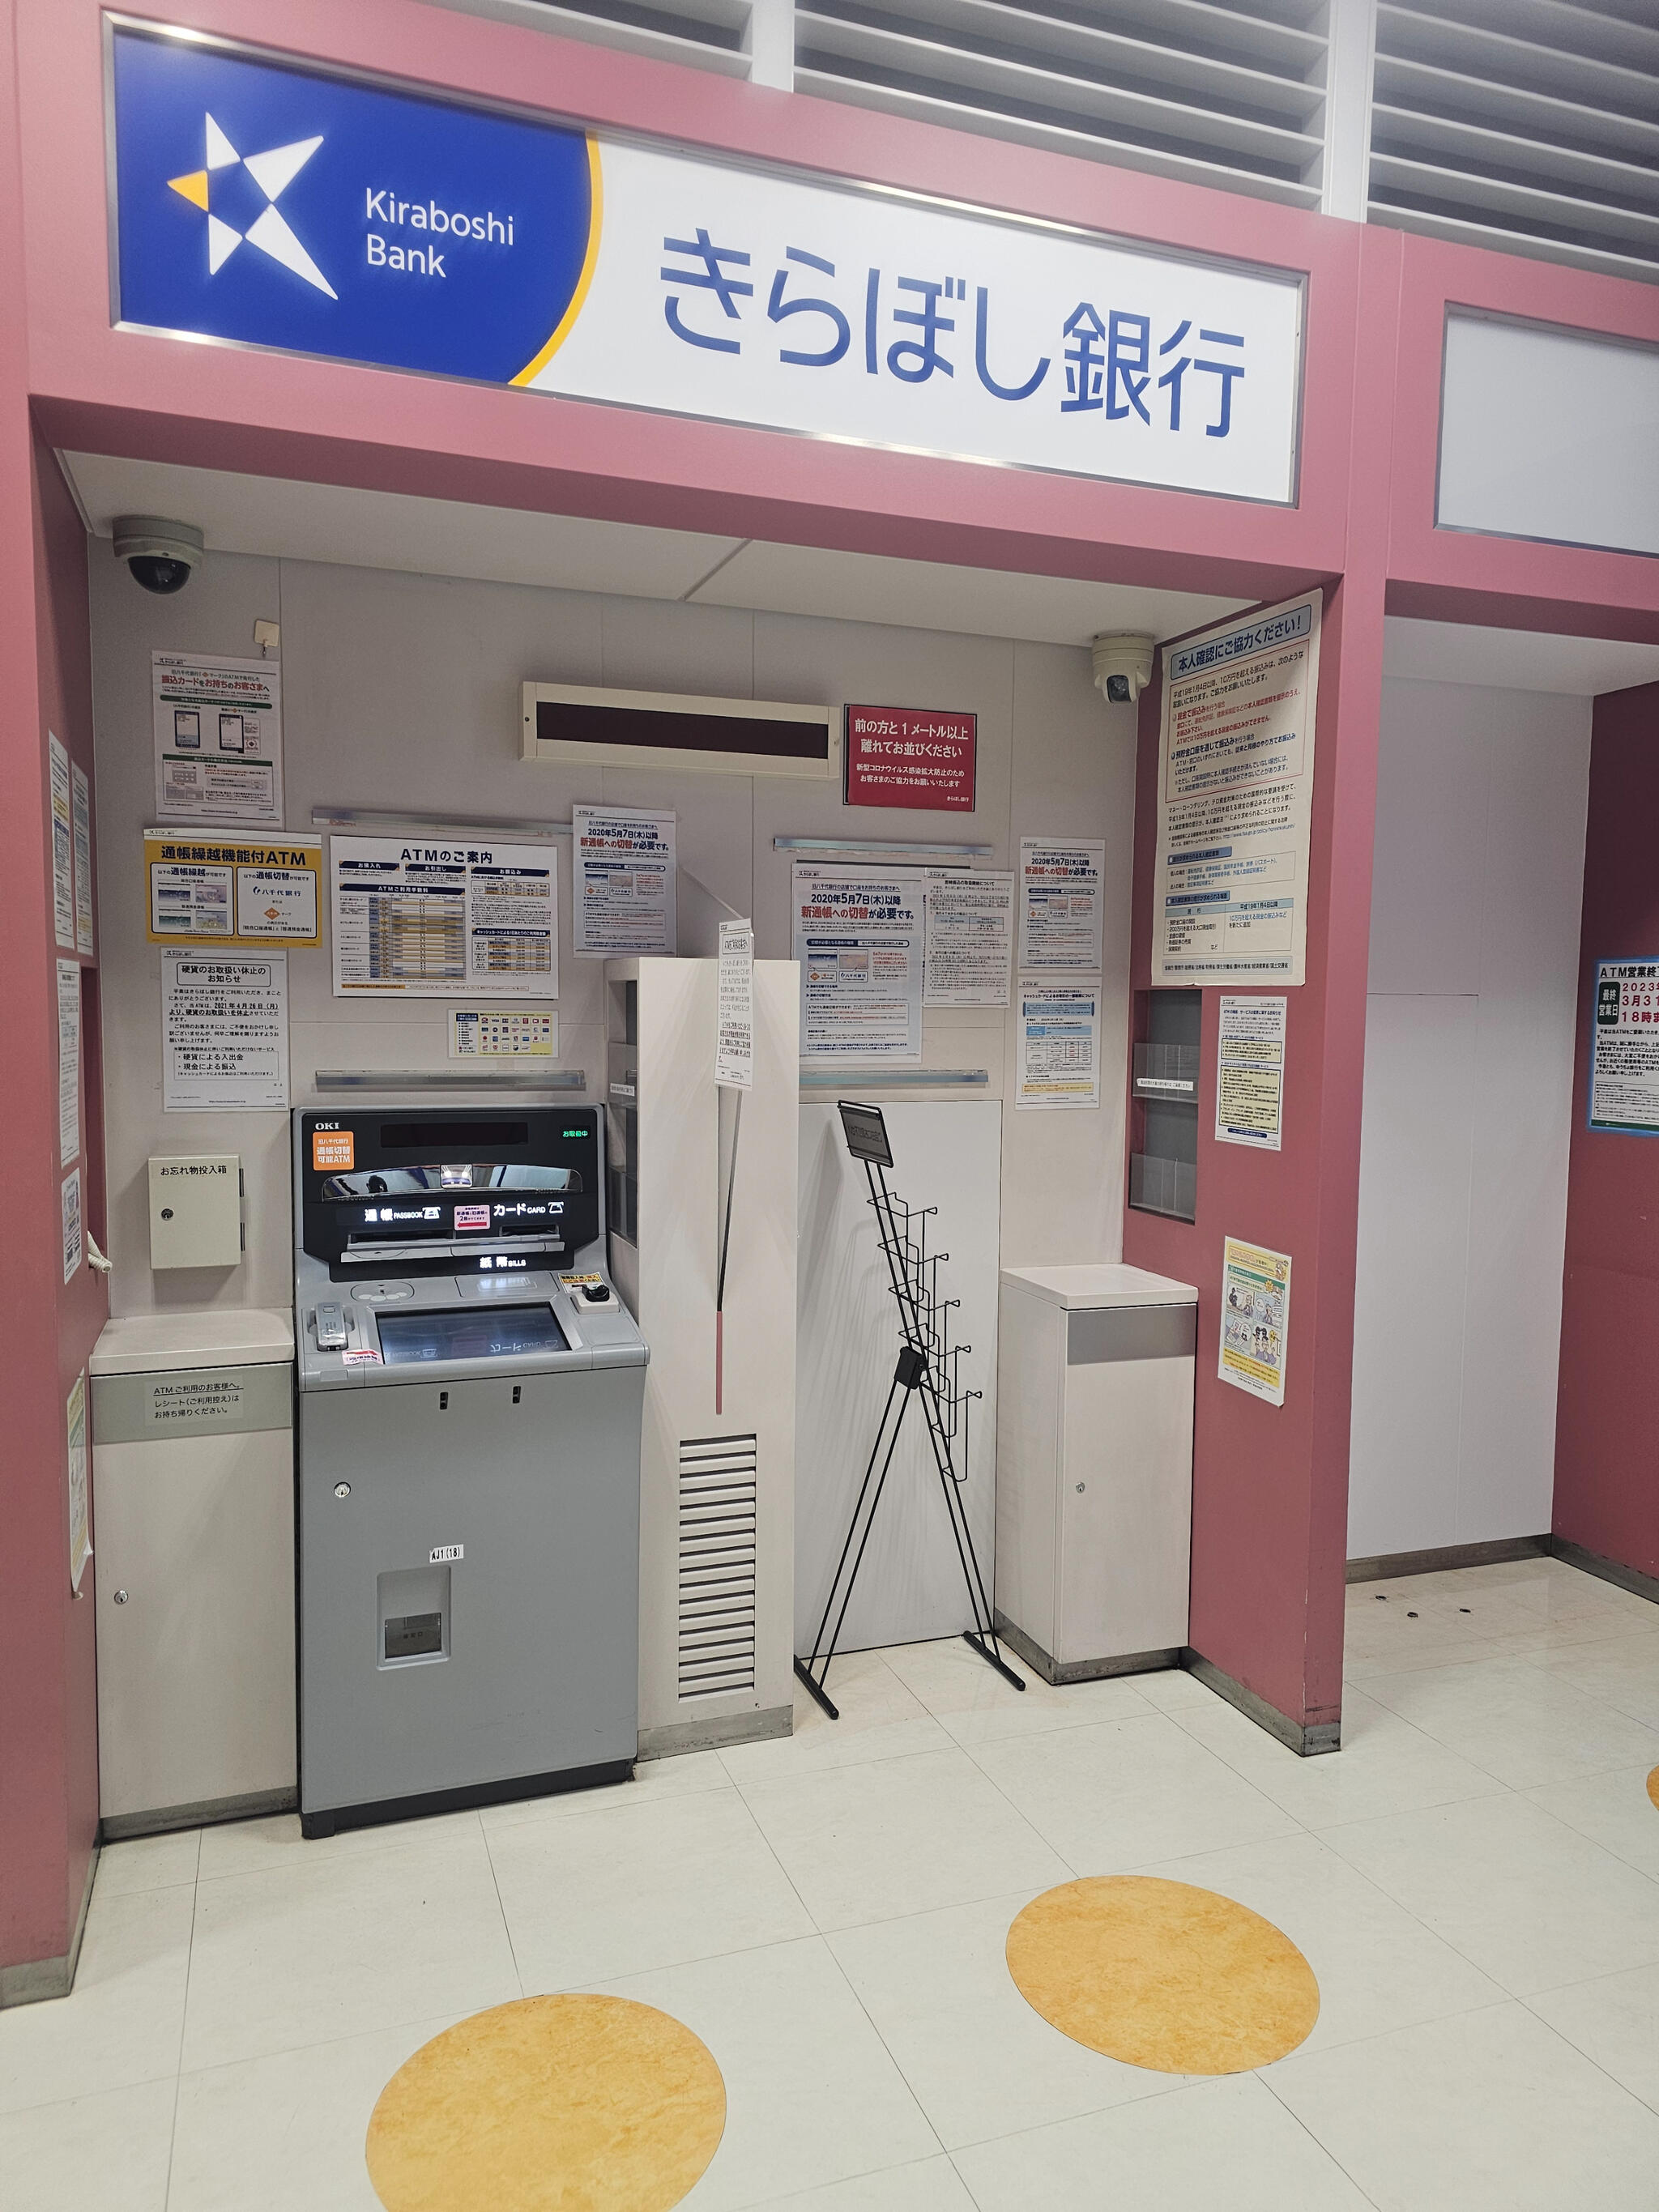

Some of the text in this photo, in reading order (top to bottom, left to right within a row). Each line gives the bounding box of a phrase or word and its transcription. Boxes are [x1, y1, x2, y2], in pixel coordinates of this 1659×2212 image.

[366, 187, 514, 246] Kiraboshi
[367, 234, 446, 278] Bank
[660, 228, 1244, 437] きらぼし銀行
[1179, 616, 1301, 672] 本人確認にご協力ください!
[861, 738, 962, 757] 離れてお並びください
[856, 764, 965, 777] 新型コロナウイルス感染拡大防止のため
[860, 775, 960, 787] お客さまのご協力をお願いいたします
[588, 829, 658, 840] 2020年5月7日(木)以降
[580, 837, 669, 850] 新通帳への切替が必要です。
[161, 846, 305, 866] 通帳繰越機能付ATM
[401, 848, 493, 864] ATMのご案内
[1031, 857, 1090, 866] 2020年5月7日(木)以降
[1025, 866, 1098, 876] 新通帳への切替が必要です。
[811, 893, 901, 906] 2020年5月7日(木)以降
[801, 906, 914, 919] 新通帳への切替が必要です。
[181, 965, 266, 975] 硬貨のお取扱い休止の
[1600, 966, 1659, 978] ATM営業終
[207, 975, 241, 983] お知らせ
[318, 1155, 350, 1163] 可能ATM
[160, 1165, 227, 1176] お忘れ物投入箱
[493, 1203, 527, 1216] カード
[155, 1395, 240, 1408] レシート(ご利用控え)は
[155, 1407, 228, 1418] お持ち帰りください。
